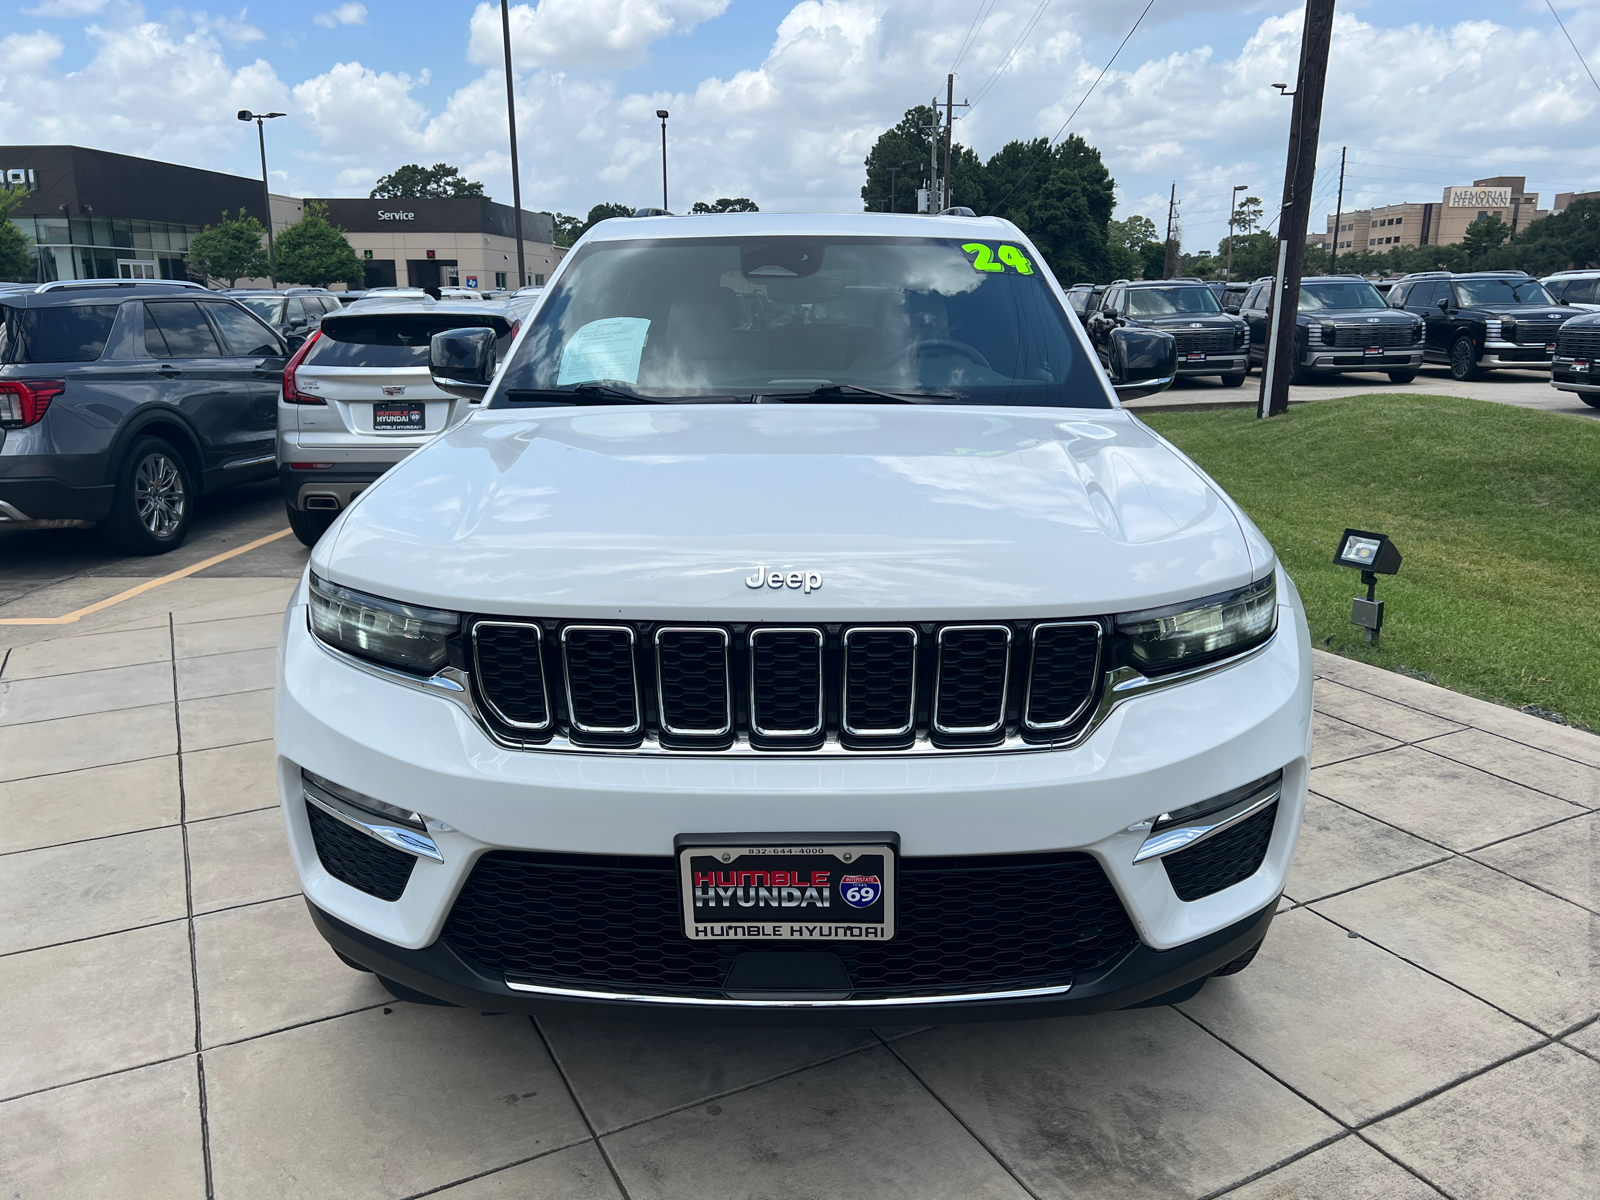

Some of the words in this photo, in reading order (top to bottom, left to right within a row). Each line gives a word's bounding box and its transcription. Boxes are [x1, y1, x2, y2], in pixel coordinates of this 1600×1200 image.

[1452, 198, 1507, 206] HERMANN
[1453, 190, 1508, 200] MEMORIAL
[377, 210, 415, 220] Service
[961, 242, 1034, 275] 24
[745, 565, 823, 595] Jeep
[694, 870, 831, 887] HUMBLE
[695, 887, 831, 908] HYUNDAI
[846, 887, 875, 902] 69
[694, 925, 783, 937] HUMBLE
[790, 925, 885, 938] HYUNDAI
